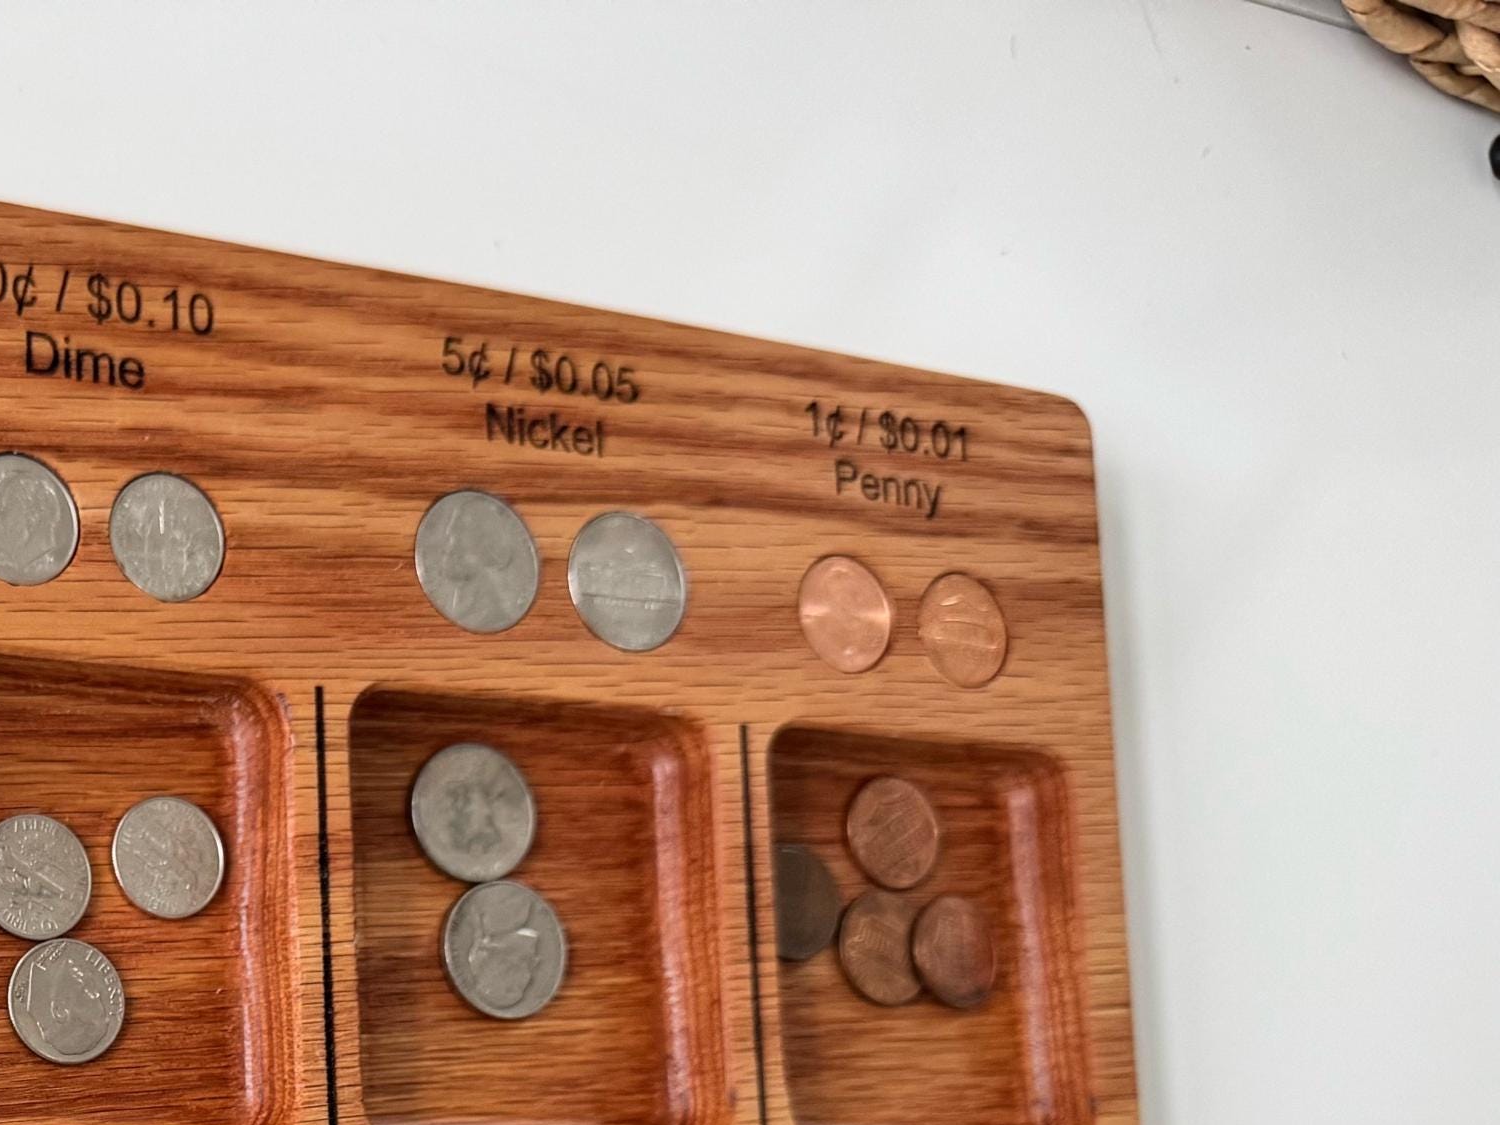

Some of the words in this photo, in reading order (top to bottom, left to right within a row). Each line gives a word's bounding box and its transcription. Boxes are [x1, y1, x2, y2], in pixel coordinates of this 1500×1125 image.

[55, 269, 70, 312] /
[87, 272, 215, 337] $0.10
[25, 331, 146, 390] Dime
[441, 336, 490, 388] 5¢
[503, 346, 518, 383] /
[529, 347, 639, 403] $0.05
[485, 403, 605, 457] Nickel
[804, 400, 844, 448] 1¢
[856, 409, 867, 445] /
[878, 409, 970, 462] $0.01
[834, 459, 942, 519] Penny
